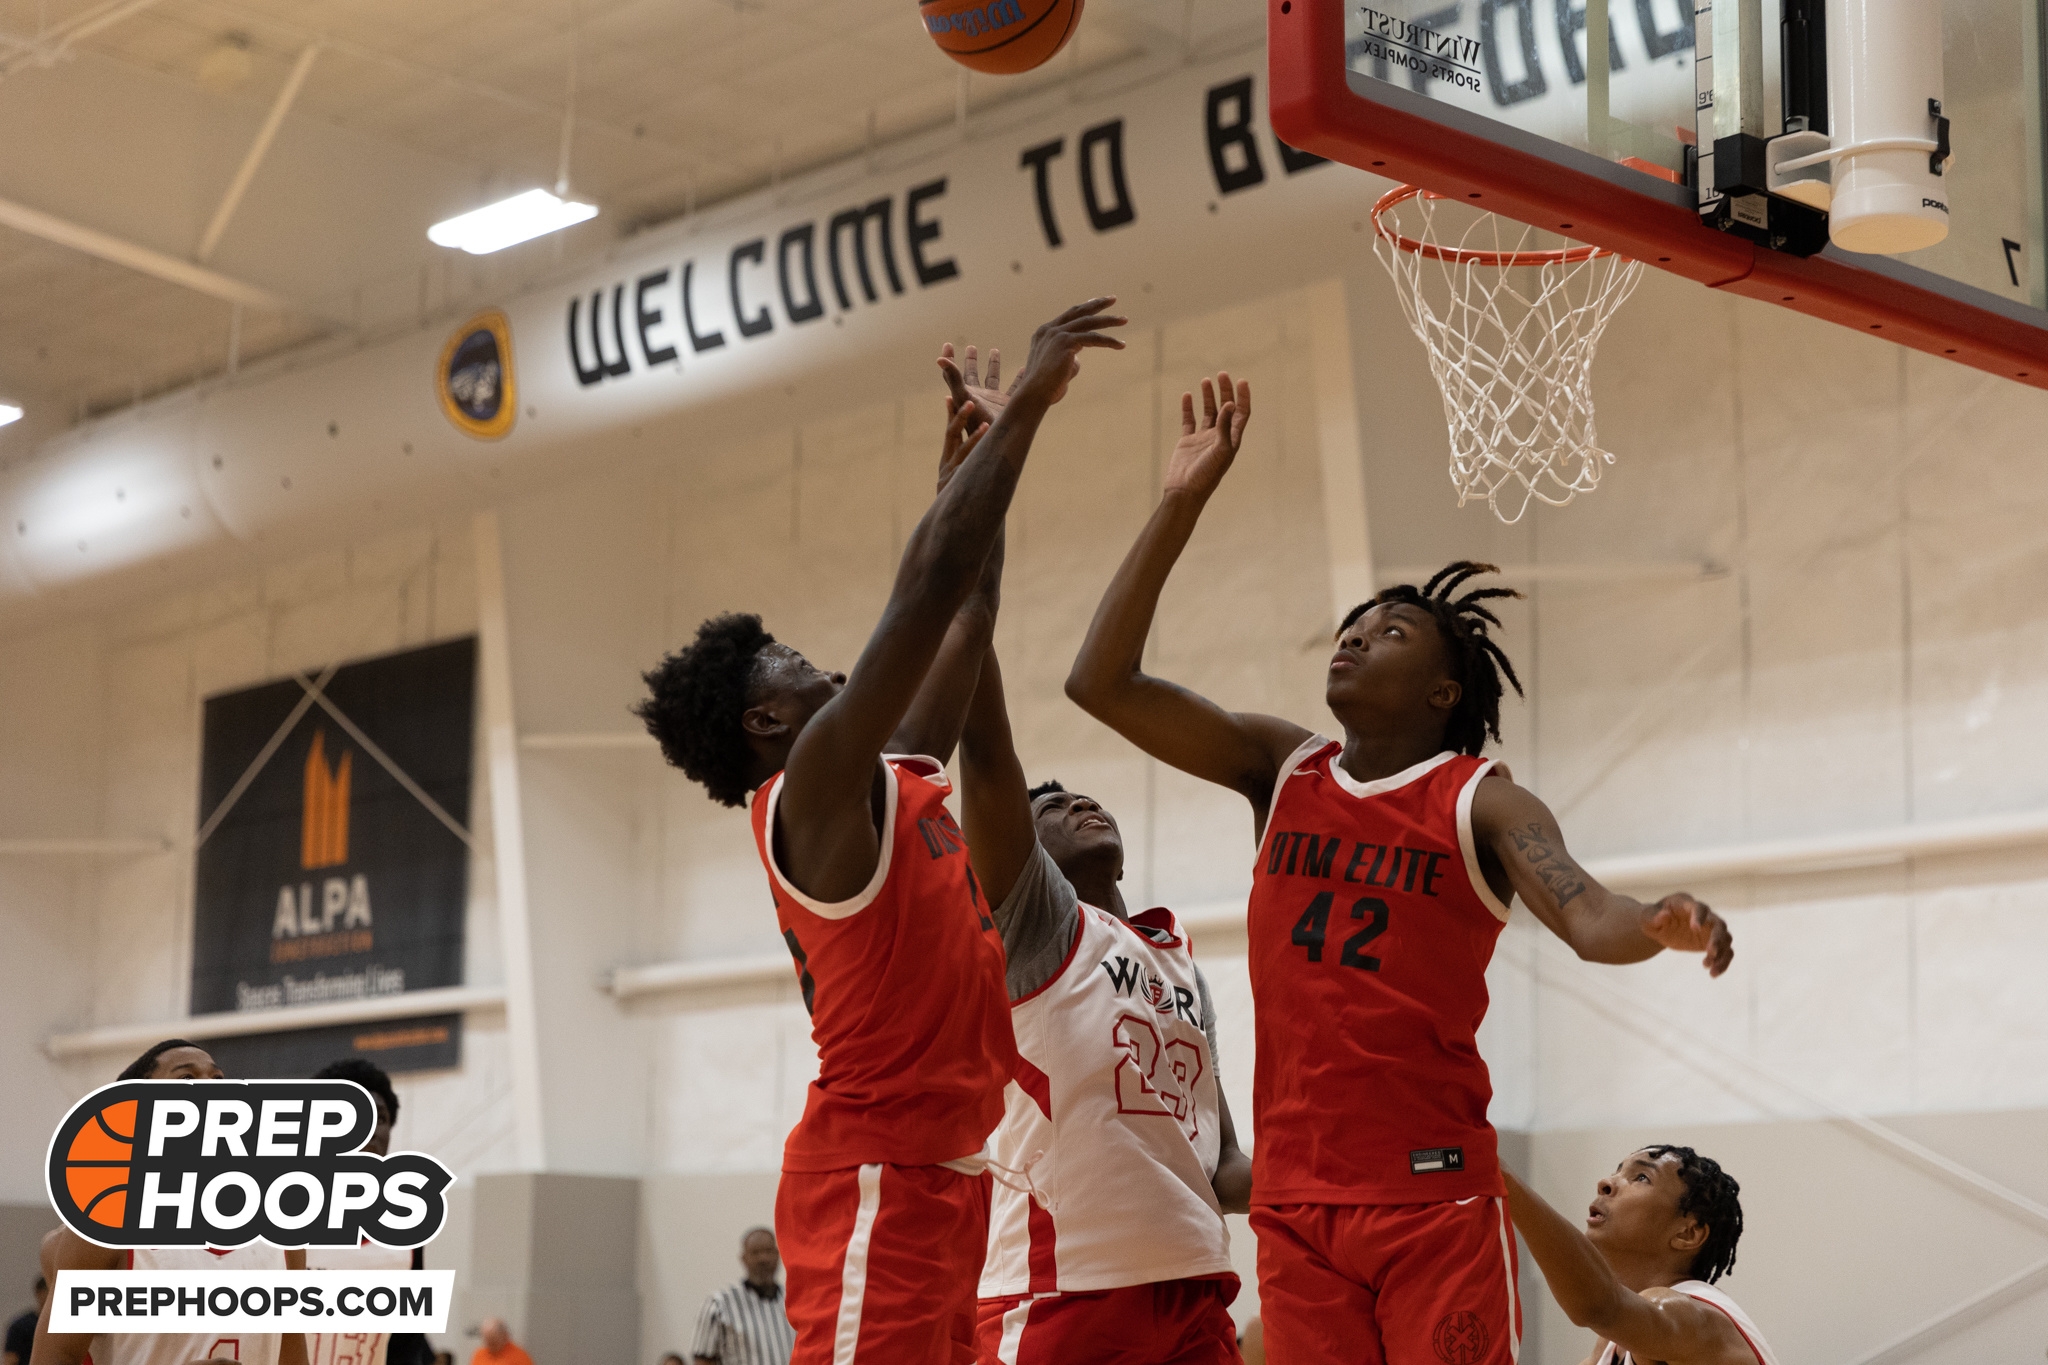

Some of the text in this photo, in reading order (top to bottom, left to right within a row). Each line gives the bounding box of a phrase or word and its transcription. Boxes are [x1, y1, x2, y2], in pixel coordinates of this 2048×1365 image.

[926, 0, 1026, 37] Wilson
[568, 176, 960, 385] WELCOME
[1020, 119, 1136, 248] TO
[1267, 832, 1450, 897] DTM ELITE
[272, 873, 373, 939] ALPA
[1292, 891, 1389, 972] 42
[1112, 1014, 1203, 1142] 23
[1448, 1153, 1459, 1164] M
